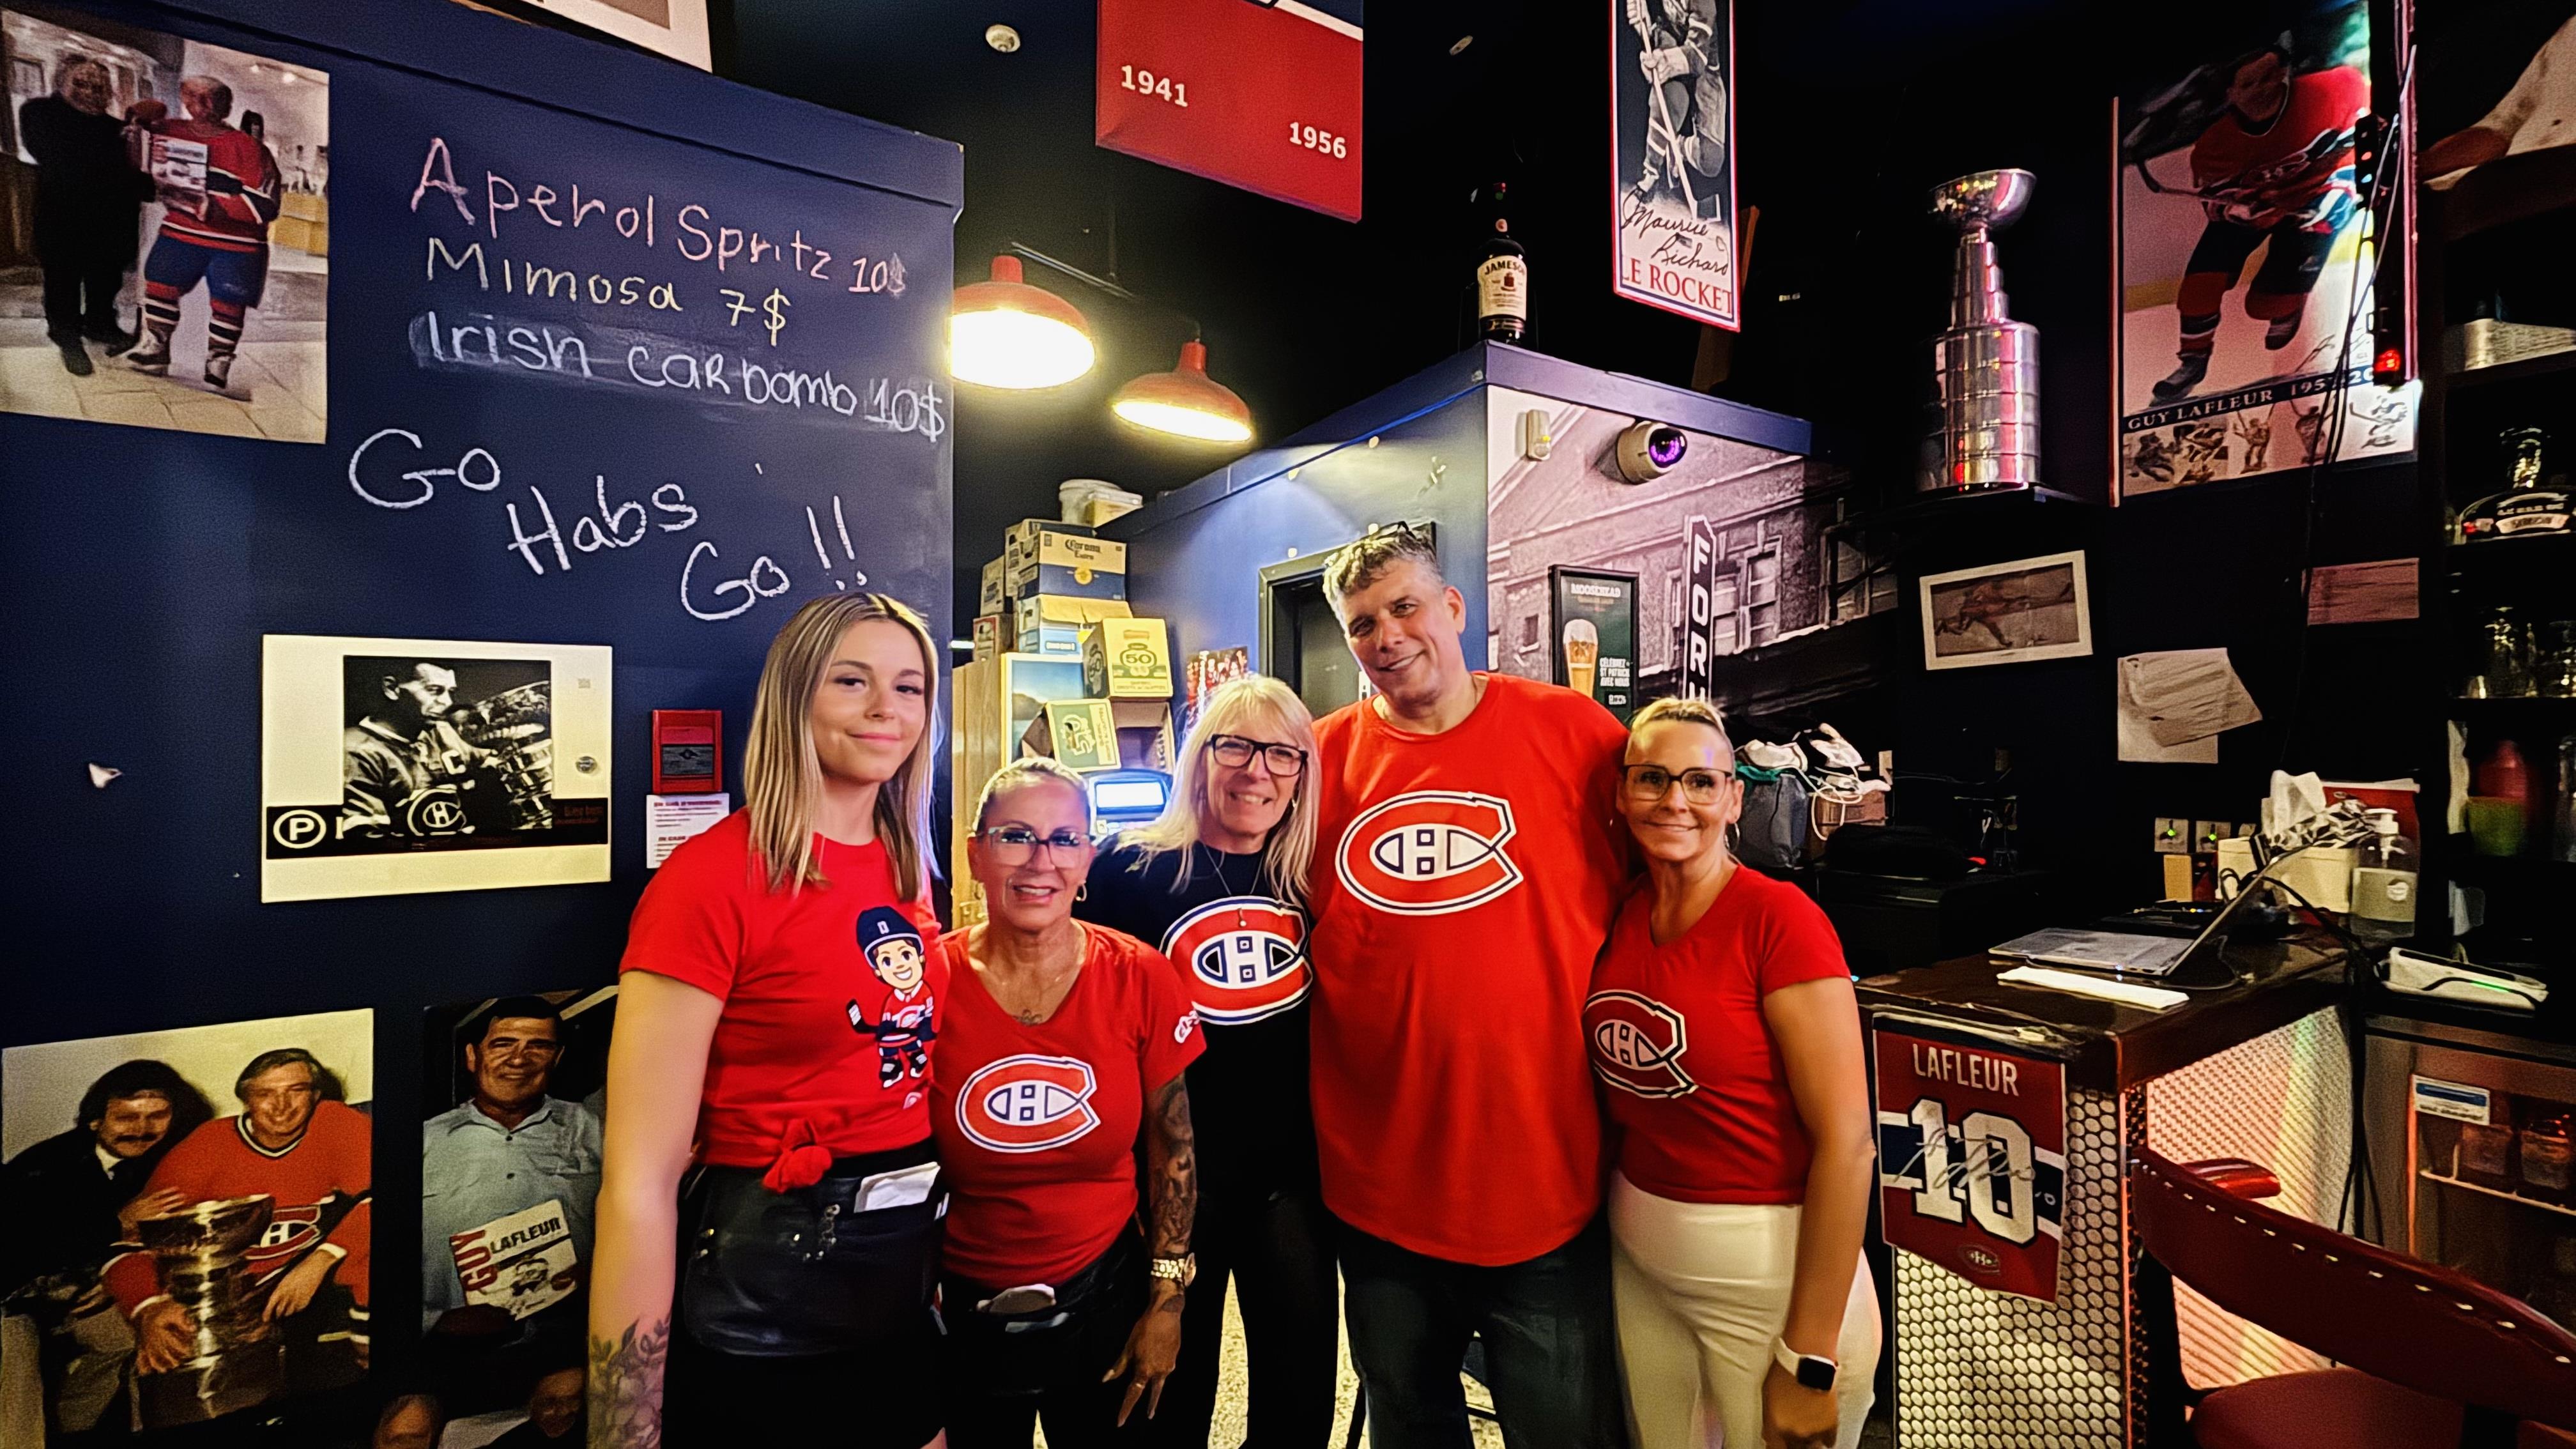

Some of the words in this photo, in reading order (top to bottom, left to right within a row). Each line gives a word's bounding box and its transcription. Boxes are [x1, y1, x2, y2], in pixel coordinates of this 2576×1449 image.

[1121, 65, 1188, 107] 1941
[1289, 121, 1347, 159] 1956
[411, 137, 654, 247] Aperol
[677, 204, 831, 280] Spritz
[1621, 188, 1708, 239] Maurice
[1651, 232, 1729, 276] Richard
[427, 237, 683, 311] Mimosa
[719, 288, 792, 347] 7$
[1648, 263, 1732, 314] ROCKET
[427, 311, 594, 378] Irish
[742, 356, 858, 416] bomb
[864, 378, 945, 443] 10$
[2128, 411, 2170, 430] GUY
[2176, 390, 2273, 420] LAFLEUR
[349, 428, 501, 509] Go
[506, 475, 698, 575] Habs
[680, 541, 790, 621] Go
[1126, 654, 1152, 664] 50
[1912, 1043, 2020, 1097] LAFLEUR
[1910, 1098, 2033, 1245] 10
[449, 1229, 498, 1291] GUY
[489, 1216, 562, 1254] LAFLEUR
